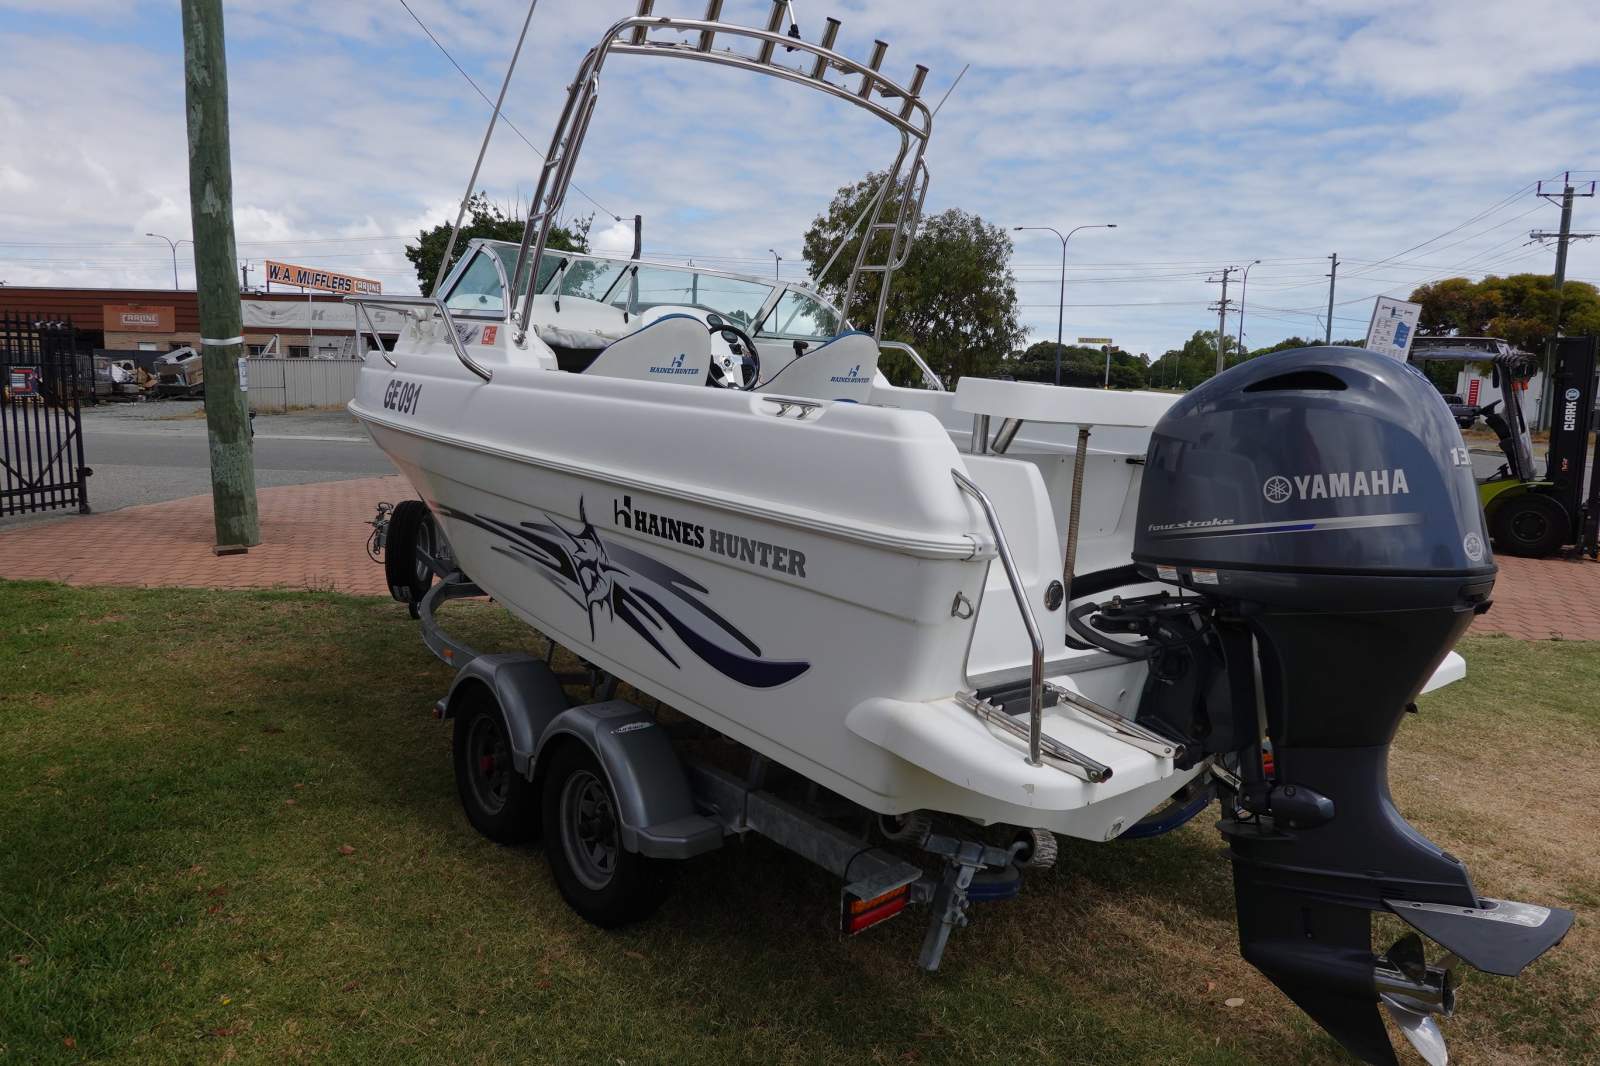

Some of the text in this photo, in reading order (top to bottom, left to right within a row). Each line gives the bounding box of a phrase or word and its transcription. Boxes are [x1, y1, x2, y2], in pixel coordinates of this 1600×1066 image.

[269, 265, 294, 282] W.A.
[296, 269, 352, 291] MUFFLERS
[1563, 401, 1577, 431] CLARK
[1294, 468, 1410, 500] YAMAHA
[634, 509, 806, 578] HAINES HUNTER
